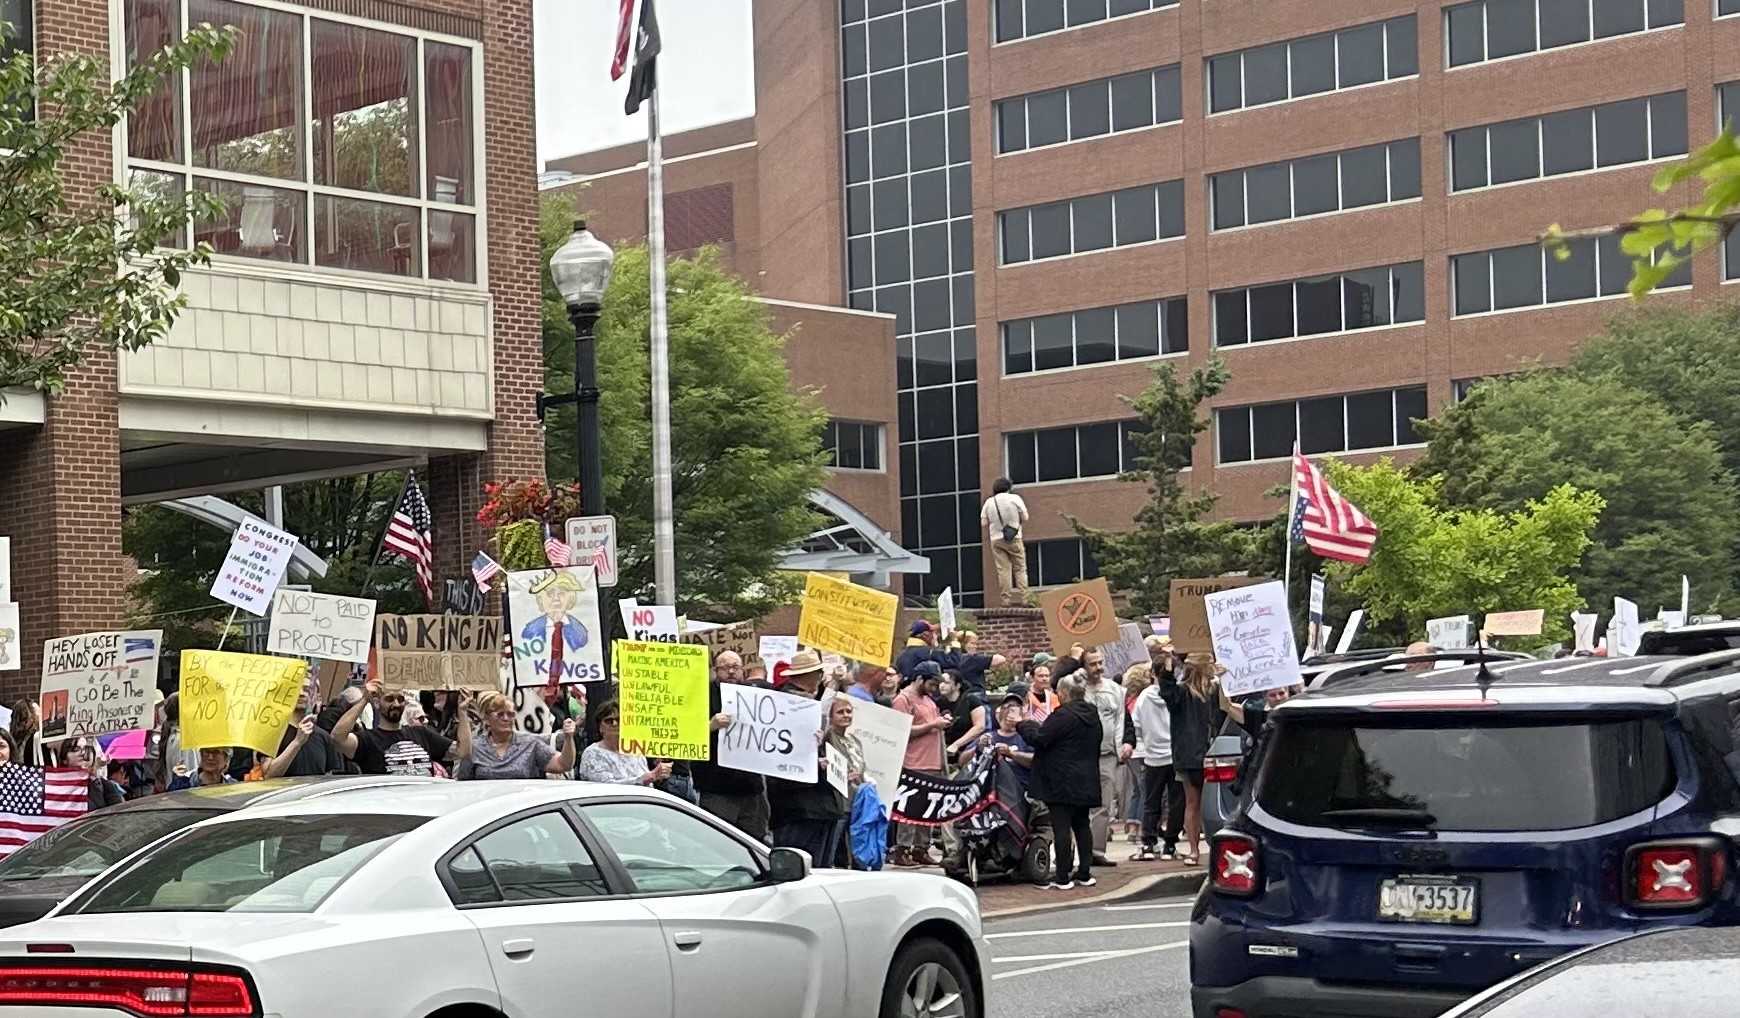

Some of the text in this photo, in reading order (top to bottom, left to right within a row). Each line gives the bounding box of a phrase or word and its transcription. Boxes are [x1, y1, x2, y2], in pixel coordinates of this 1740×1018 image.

[574, 523, 607, 535] DO NOT
[249, 550, 268, 562] JOB
[254, 540, 279, 555] YOUR
[226, 573, 265, 596] REFORM
[239, 567, 263, 583] TION
[230, 589, 254, 603] NOW
[278, 594, 370, 617] NOT PAID
[312, 614, 332, 629] to
[632, 610, 655, 627] NO
[278, 628, 367, 656] PROTEST
[381, 616, 408, 649] NO
[805, 623, 830, 646] NO
[52, 637, 79, 654] HEY
[513, 638, 545, 660] NO
[48, 650, 118, 673] HANDS OFF
[190, 655, 210, 672] BY
[241, 657, 305, 683] PEOPLE
[76, 681, 144, 704] GO Be The
[185, 676, 209, 696] FOR
[233, 678, 297, 707] PEOPLE
[193, 699, 283, 728] NO KINGS
[621, 738, 708, 759] UNACCEPTABLE
[723, 722, 794, 755] KINGS
